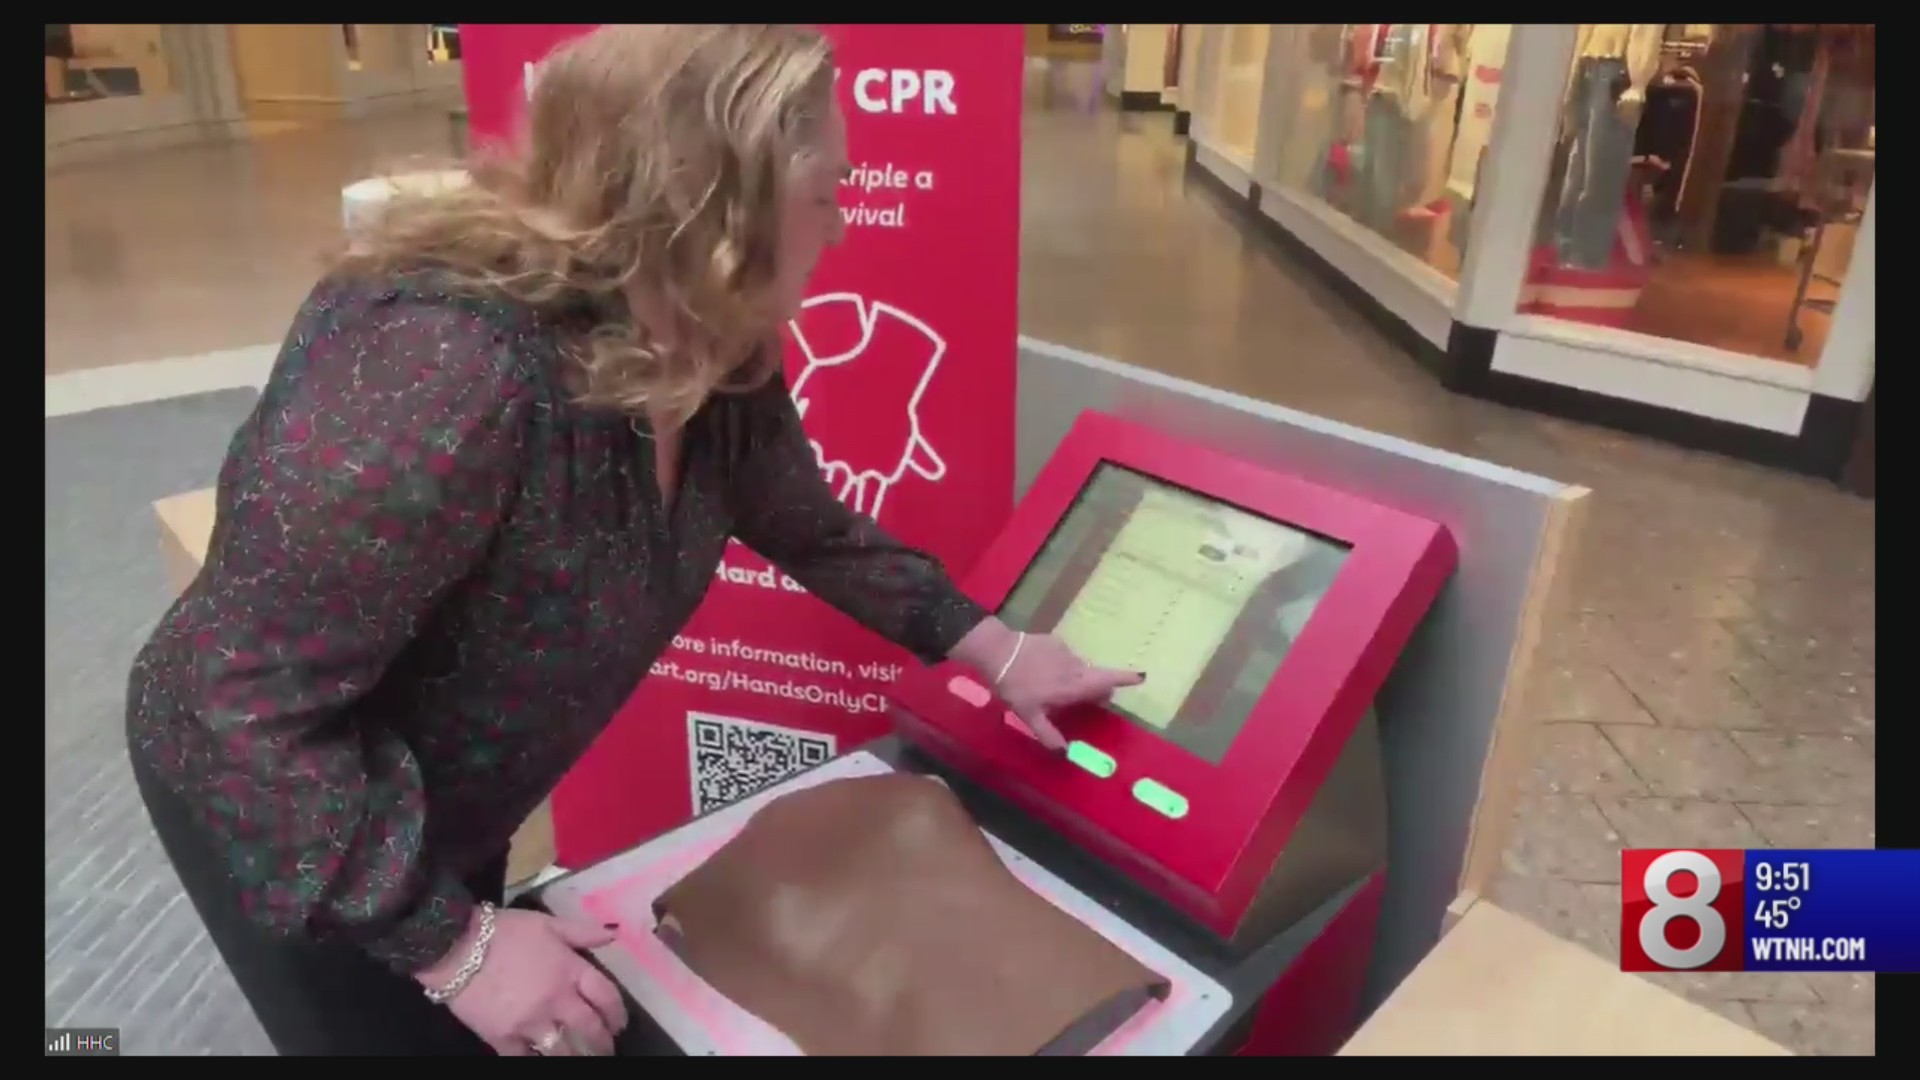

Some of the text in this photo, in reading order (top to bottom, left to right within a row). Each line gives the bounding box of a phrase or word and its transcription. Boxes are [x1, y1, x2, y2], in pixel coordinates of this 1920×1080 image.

[854, 68, 957, 115] CPR
[915, 171, 934, 189] a
[672, 634, 705, 653] ore
[711, 638, 852, 679] information,
